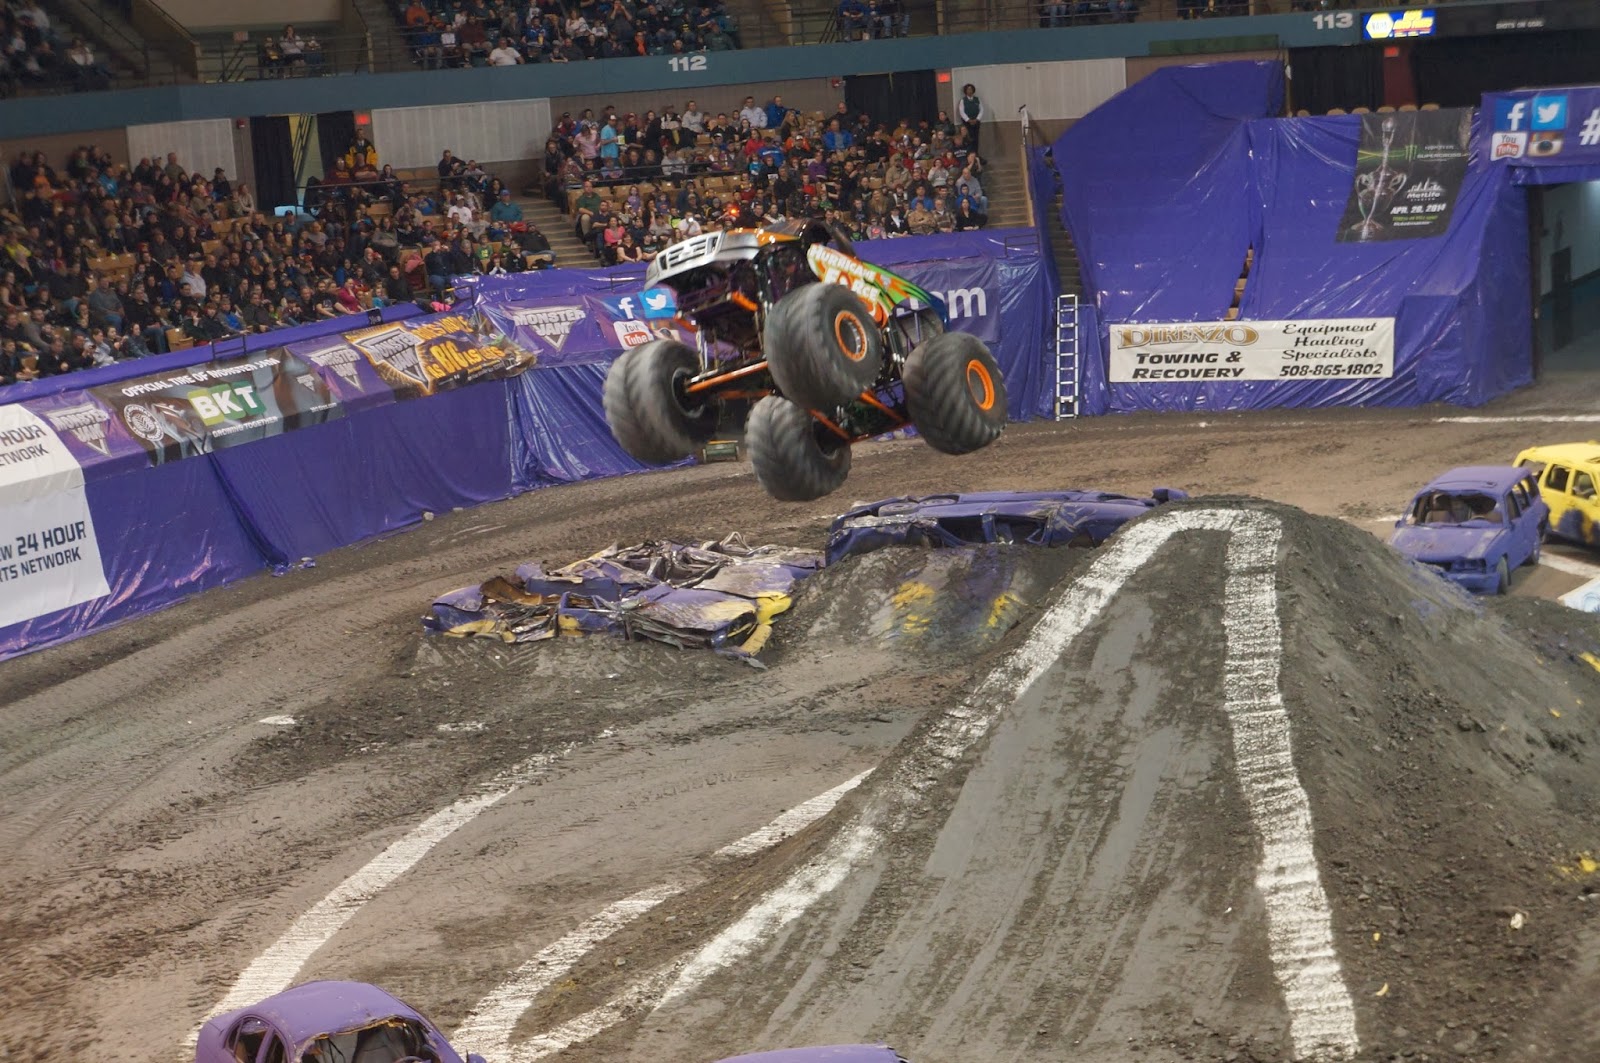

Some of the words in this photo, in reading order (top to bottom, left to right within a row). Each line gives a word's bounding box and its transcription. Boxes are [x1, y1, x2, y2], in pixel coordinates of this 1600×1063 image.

[1312, 12, 1354, 30] 113
[668, 55, 707, 72] 112
[1501, 134, 1518, 144] You
[1496, 144, 1520, 157] Tube
[1407, 191, 1441, 199] MetLife
[808, 244, 877, 282] HURRICANE
[513, 308, 587, 327] MONSTER
[533, 321, 571, 337] JAM
[623, 323, 639, 333] You
[1282, 322, 1377, 336] Equipment
[625, 333, 649, 345] Tube
[1117, 324, 1260, 350] DIRENZO
[1294, 336, 1364, 348] Hauling
[368, 332, 419, 362] MONSTER
[1281, 348, 1377, 361] Specialists
[387, 347, 419, 372] JAM
[429, 340, 469, 374] BIG
[1135, 353, 1219, 365] TOWING
[1225, 351, 1243, 363] &
[121, 379, 174, 398] OFFICIAL
[168, 373, 196, 387] TIRE
[194, 370, 209, 382] OF
[207, 362, 259, 379] MONSTER
[255, 357, 281, 371] JAM
[1132, 367, 1246, 379] RECOVERY
[1279, 363, 1384, 377] 508-865-1802
[190, 385, 258, 420] BKT
[212, 425, 244, 438] GROWING
[242, 415, 279, 430] TOGETHER
[0, 424, 47, 447] HOUR
[16, 532, 39, 557] 24
[43, 521, 87, 550] HOUR
[21, 546, 82, 576] NETWORK
